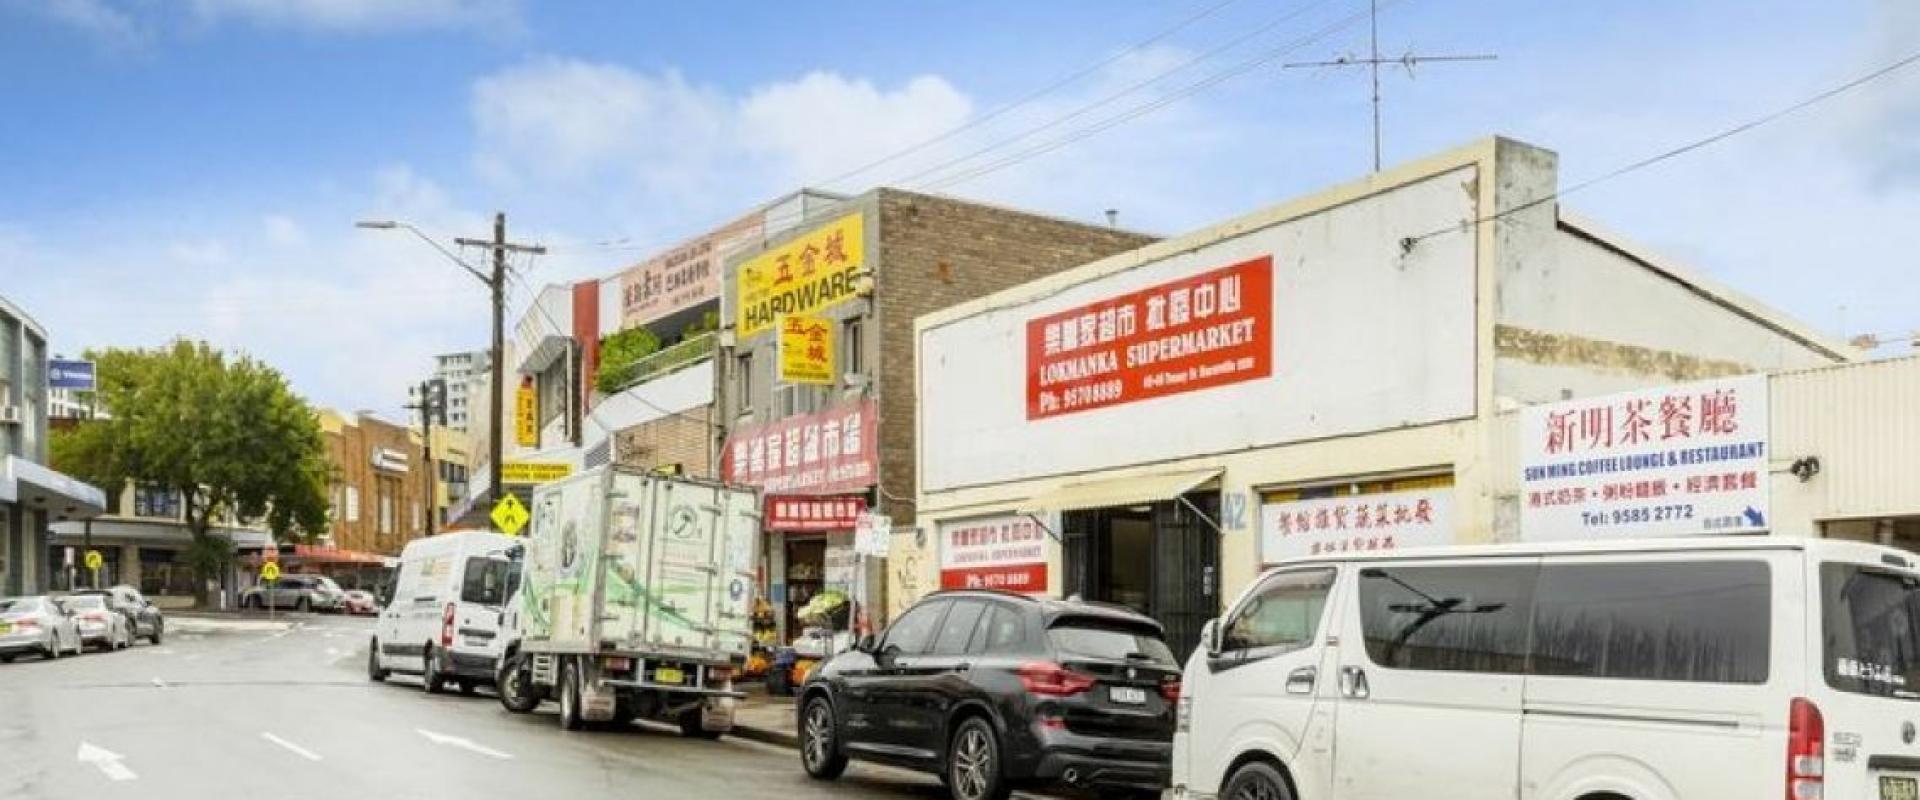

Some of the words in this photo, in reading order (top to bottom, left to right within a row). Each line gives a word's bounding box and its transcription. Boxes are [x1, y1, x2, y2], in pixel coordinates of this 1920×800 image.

[744, 266, 858, 331] HARDWARE
[1040, 350, 1118, 386] LOKMANKA
[1126, 318, 1256, 368] SUPERMARKET
[1040, 390, 1061, 413] Ph:
[1544, 388, 1739, 455] 新明茶餐廳
[1524, 464, 1547, 482] SUN
[1547, 462, 1576, 479] MING
[1578, 457, 1618, 476] COFFEE
[1619, 453, 1666, 471] LOUNGE
[1668, 451, 1678, 466] &
[1680, 441, 1765, 465] RESTAURANT
[1581, 511, 1609, 527] Tel:
[1612, 507, 1650, 524] 9585
[1654, 504, 1694, 521] 2772
